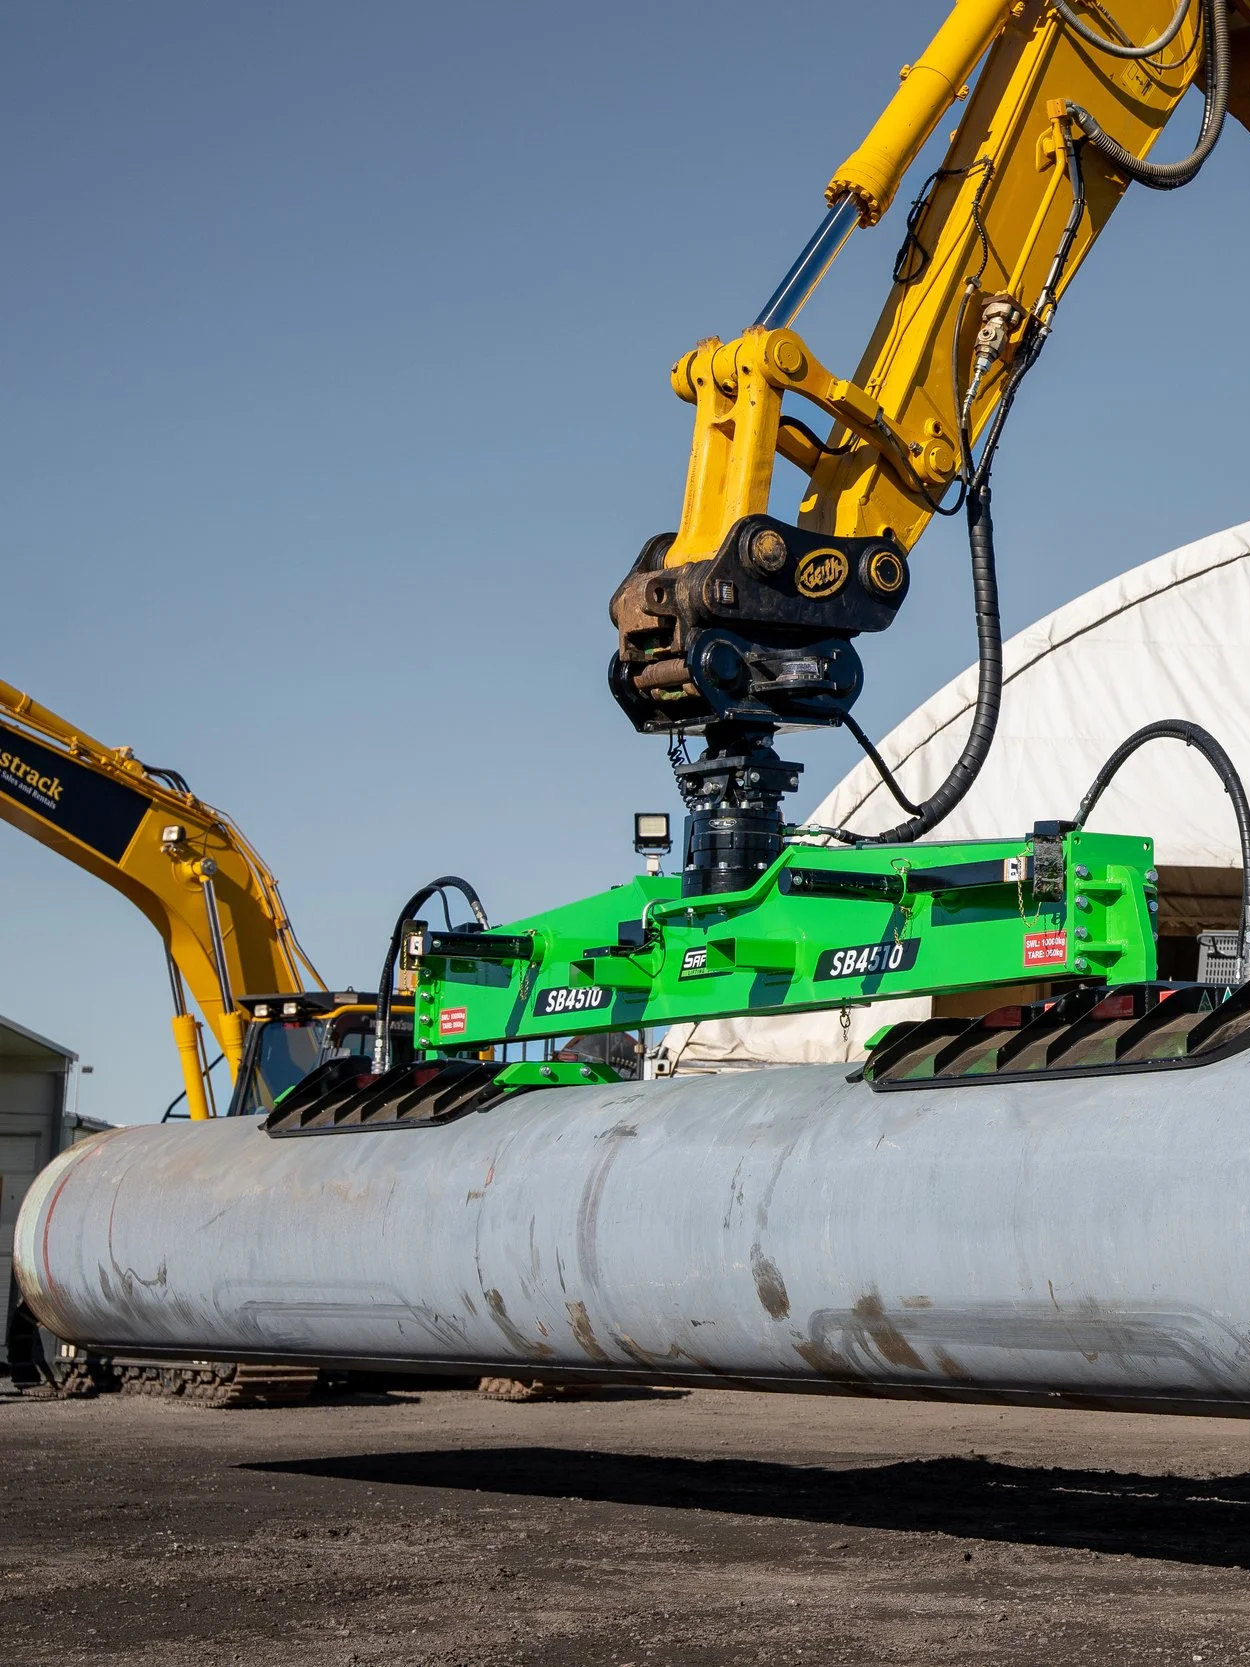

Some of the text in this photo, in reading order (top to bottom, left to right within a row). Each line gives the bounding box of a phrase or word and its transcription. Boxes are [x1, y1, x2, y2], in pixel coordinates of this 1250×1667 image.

[0, 752, 63, 801] strack
[830, 944, 904, 977] SB4510
[546, 987, 603, 1013] SB4510
